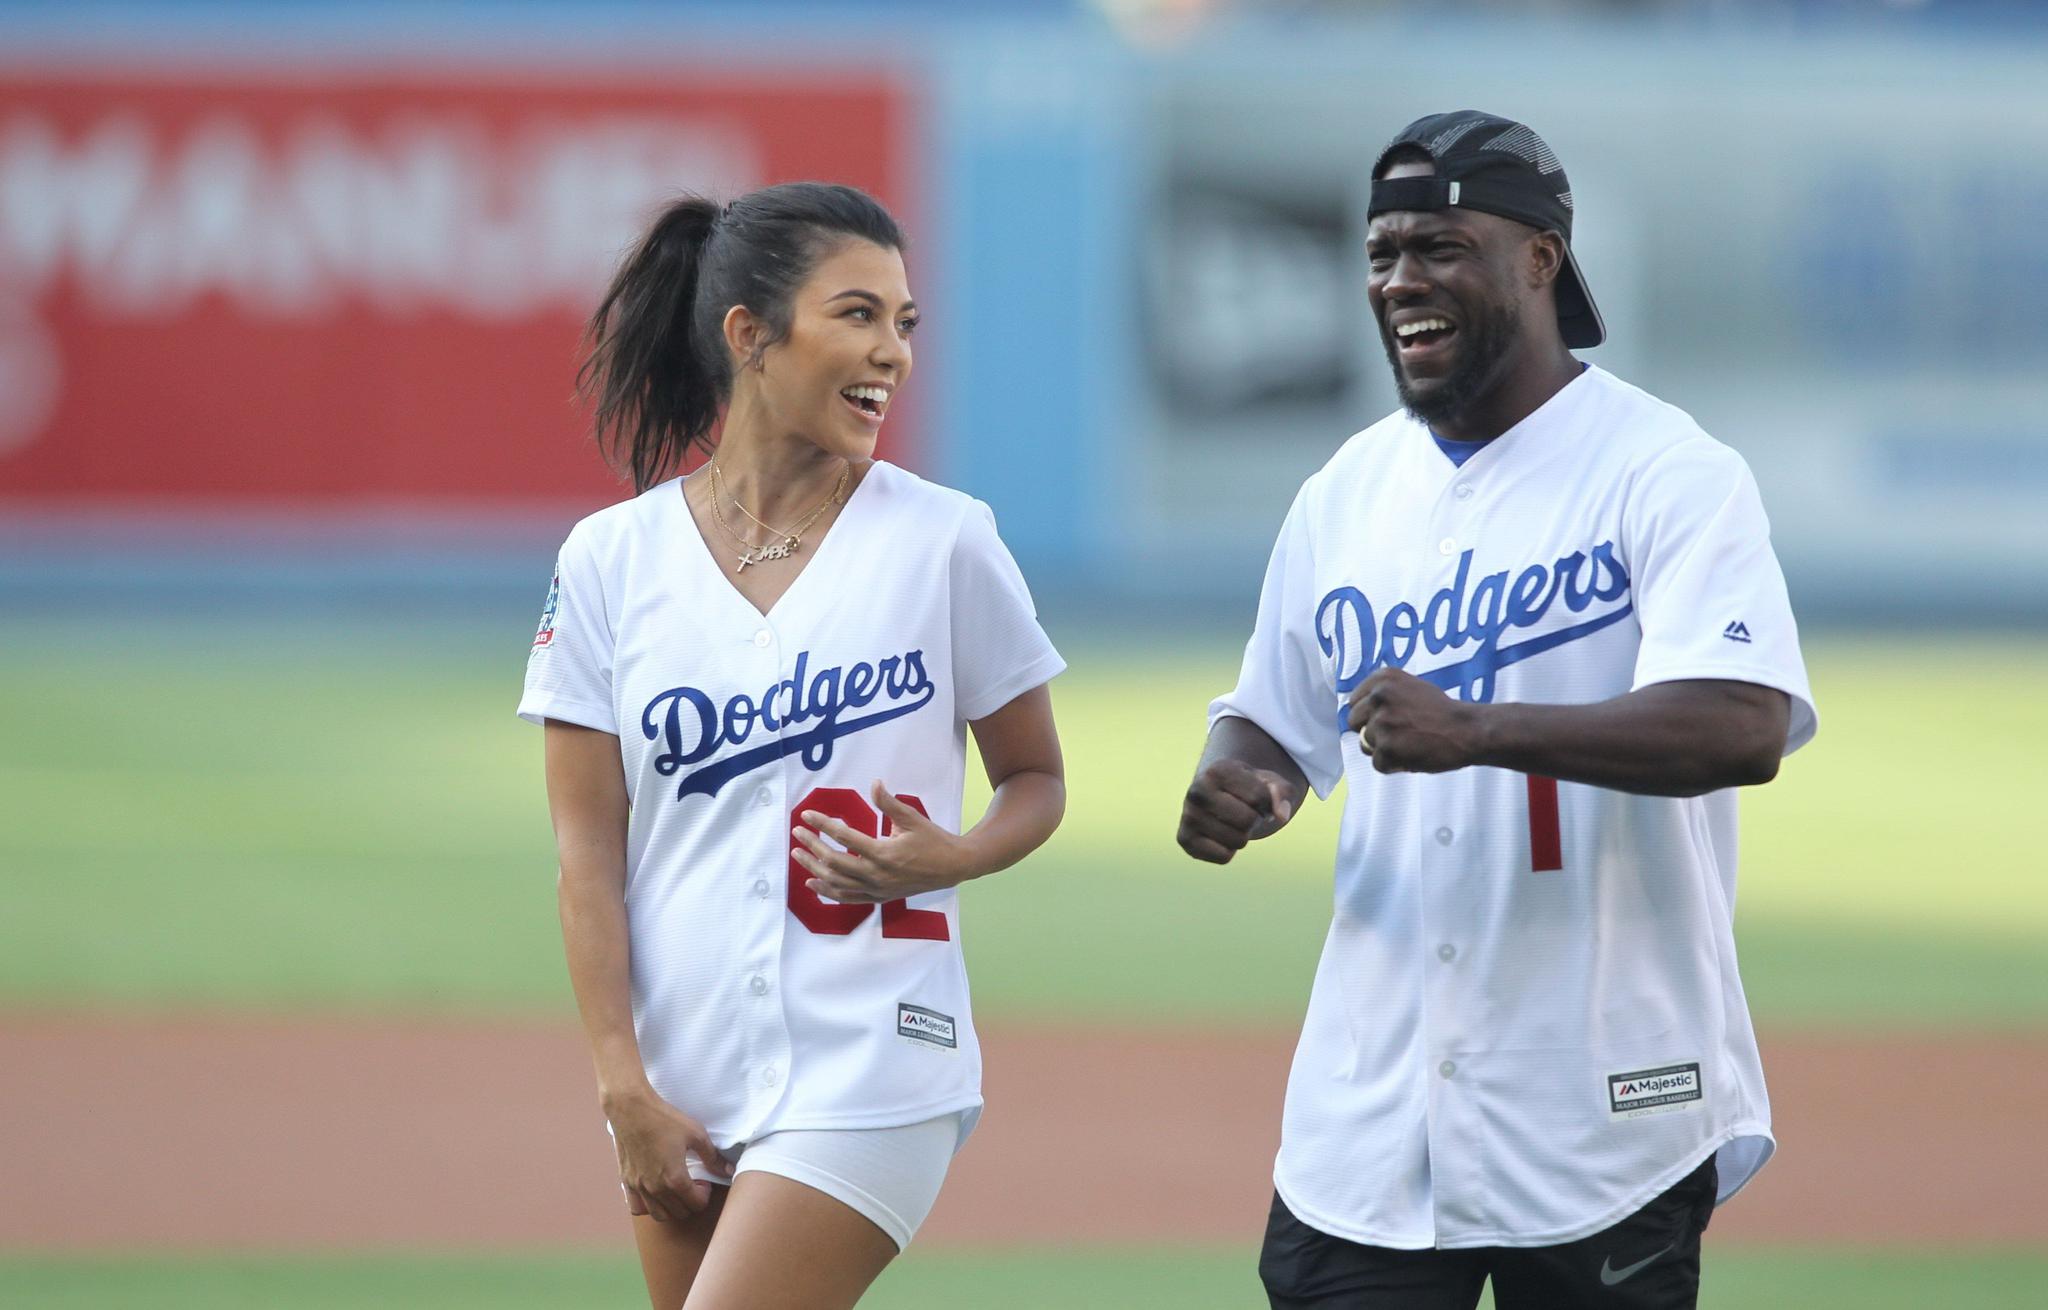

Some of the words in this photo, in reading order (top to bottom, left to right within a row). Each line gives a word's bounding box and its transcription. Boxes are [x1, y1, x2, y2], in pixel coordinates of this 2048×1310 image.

[1315, 540, 1633, 703] Dodgers
[641, 650, 935, 776] Dodgers
[920, 1015, 950, 1034] Majestic
[1639, 1074, 1692, 1092] Majestic
